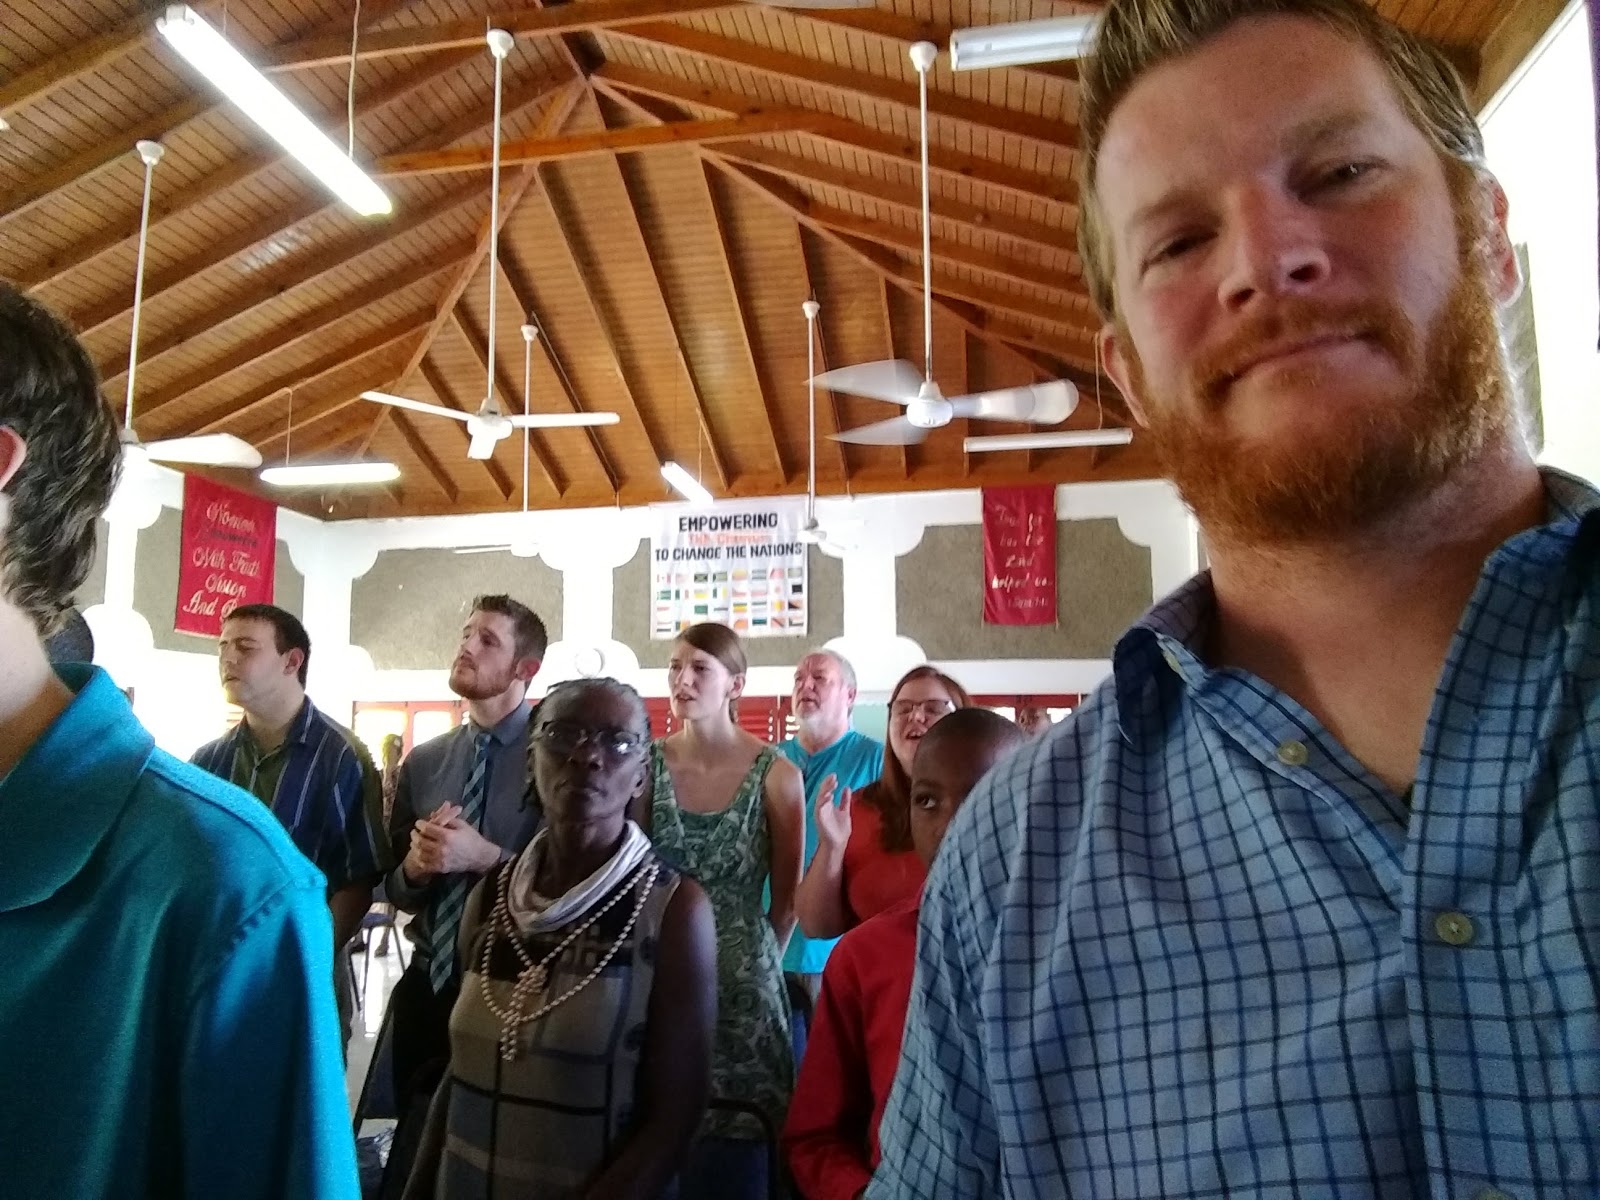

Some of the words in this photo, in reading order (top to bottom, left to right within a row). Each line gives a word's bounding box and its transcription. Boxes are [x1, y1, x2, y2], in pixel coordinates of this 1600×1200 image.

[678, 512, 779, 533] EMPOWERING
[655, 548, 669, 562] TO
[672, 546, 722, 561] CHANGE
[725, 545, 747, 559] THE
[750, 543, 803, 558] NATIONS
[205, 571, 247, 599] Vision
[182, 589, 219, 616] And
